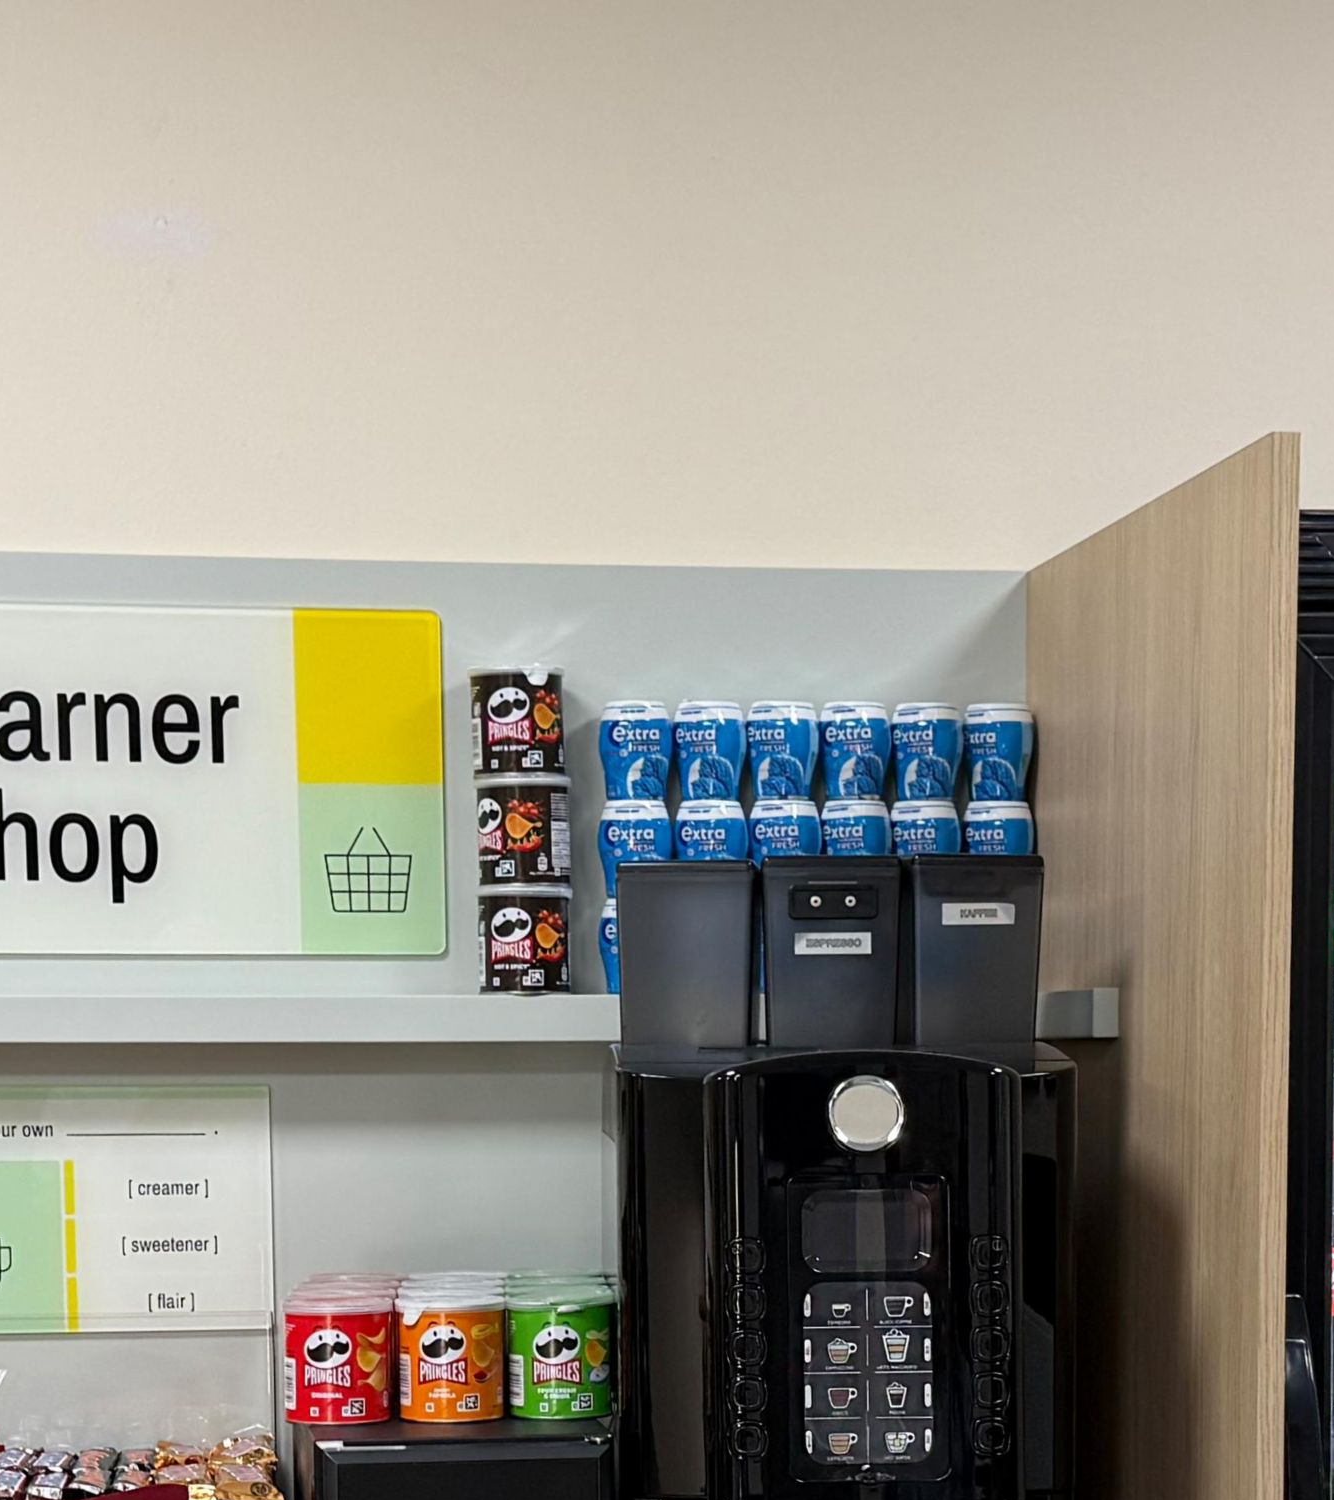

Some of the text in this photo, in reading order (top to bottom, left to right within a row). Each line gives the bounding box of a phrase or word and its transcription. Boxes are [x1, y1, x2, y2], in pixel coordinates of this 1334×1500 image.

[488, 719, 530, 742] PRINGLES
[612, 725, 660, 743] extra
[825, 725, 872, 743] extra
[969, 731, 997, 745] xtra
[607, 825, 654, 841] extra
[681, 825, 725, 841] extra
[755, 823, 798, 840] extra
[491, 938, 531, 961] PRINGLES
[22, 1124, 54, 1138] own
[138, 1181, 200, 1196] creamer
[131, 1238, 210, 1253] sweetener
[157, 1293, 186, 1310] flair
[304, 1363, 351, 1388] PRINGLES
[419, 1360, 466, 1383] PRINGLES
[534, 1360, 581, 1383] PRINGLES
